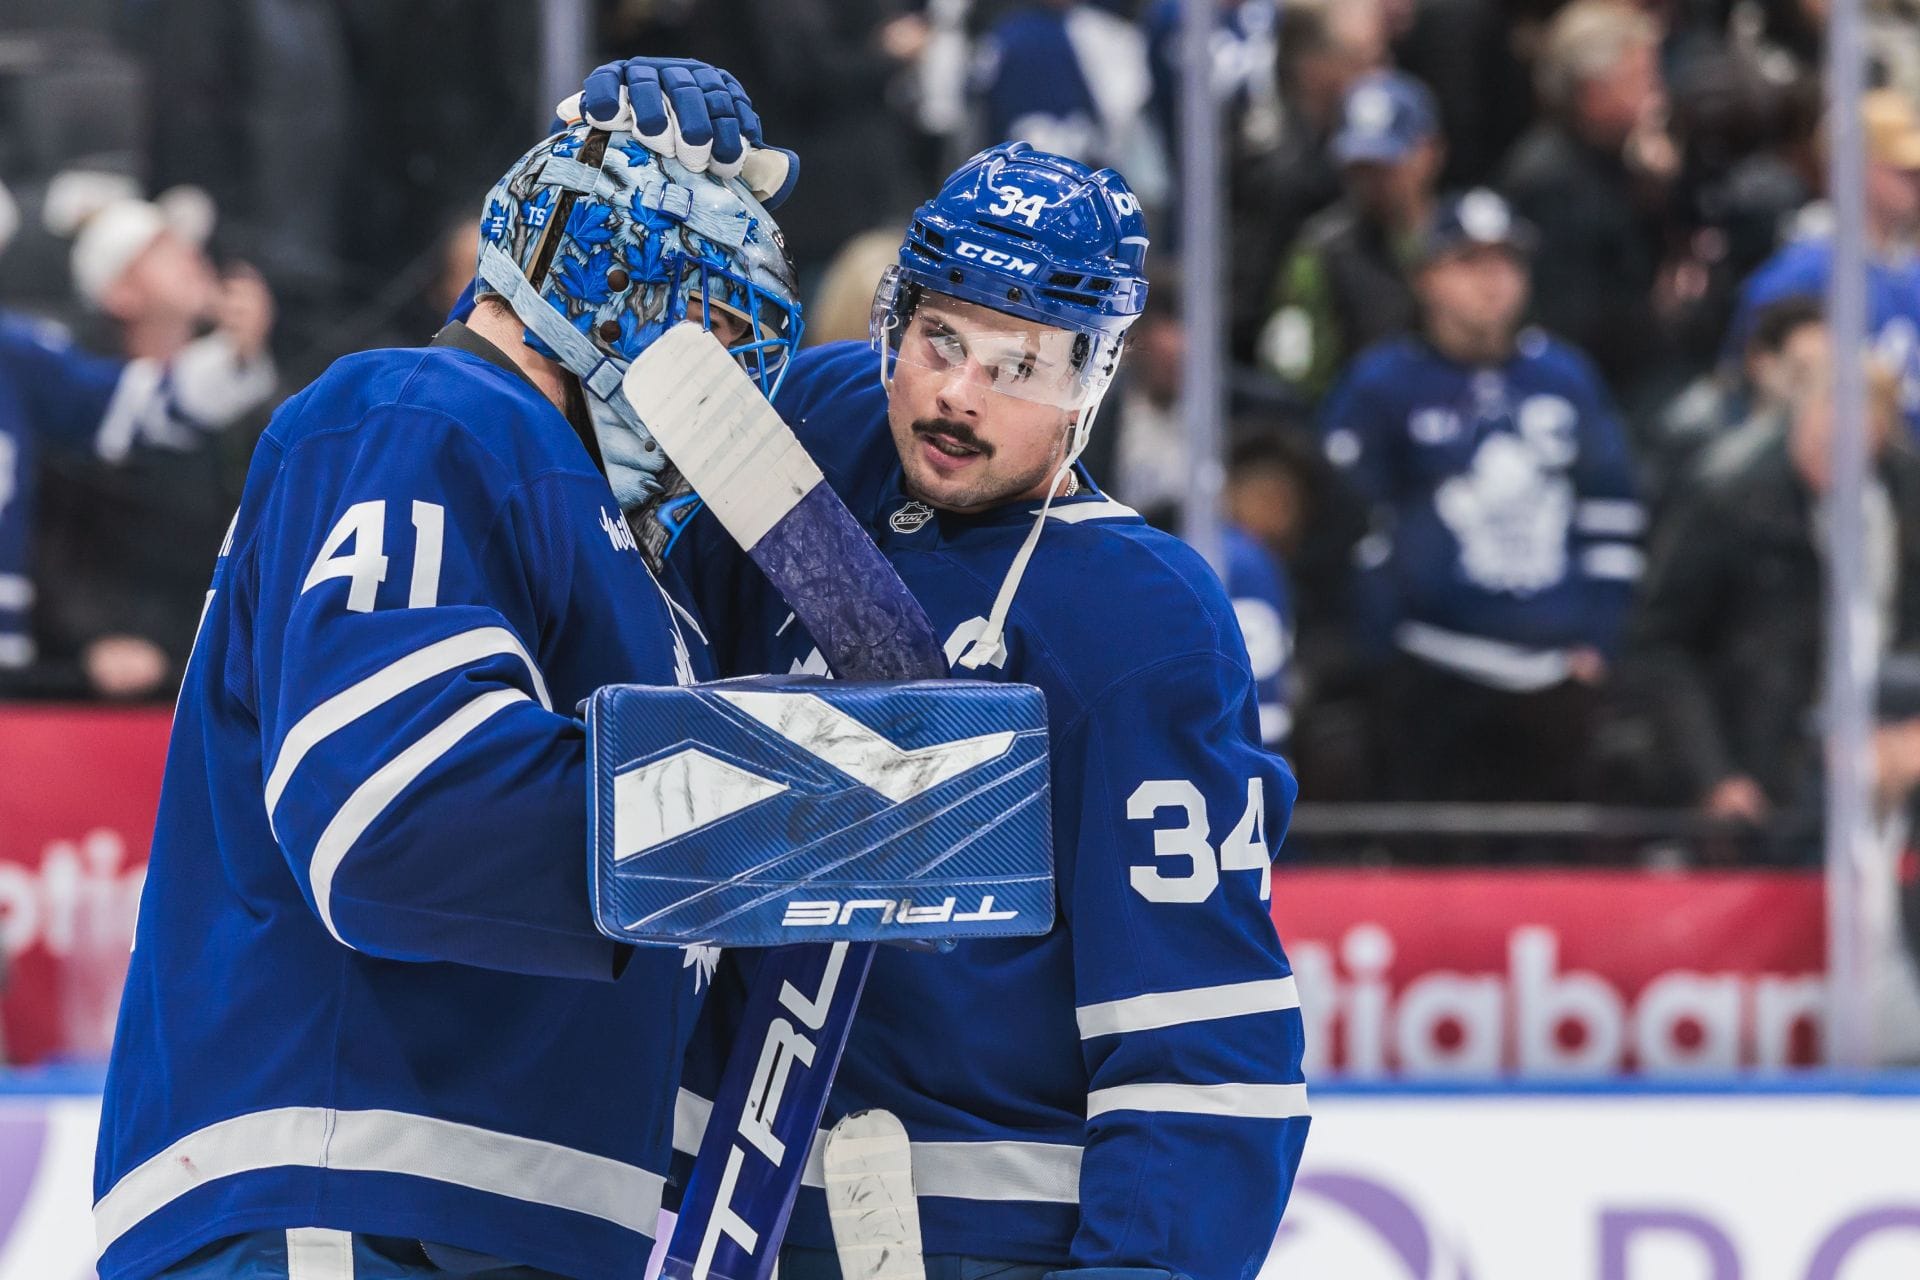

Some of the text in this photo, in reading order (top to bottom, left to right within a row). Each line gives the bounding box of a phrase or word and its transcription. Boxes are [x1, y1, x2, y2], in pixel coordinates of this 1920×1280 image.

[527, 205, 547, 226] TS
[989, 185, 1047, 227] 34
[955, 241, 1038, 276] CCM
[896, 514, 923, 523] NHL
[301, 499, 444, 613] 41
[1126, 777, 1272, 903] 34
[782, 895, 1019, 926] TRUE
